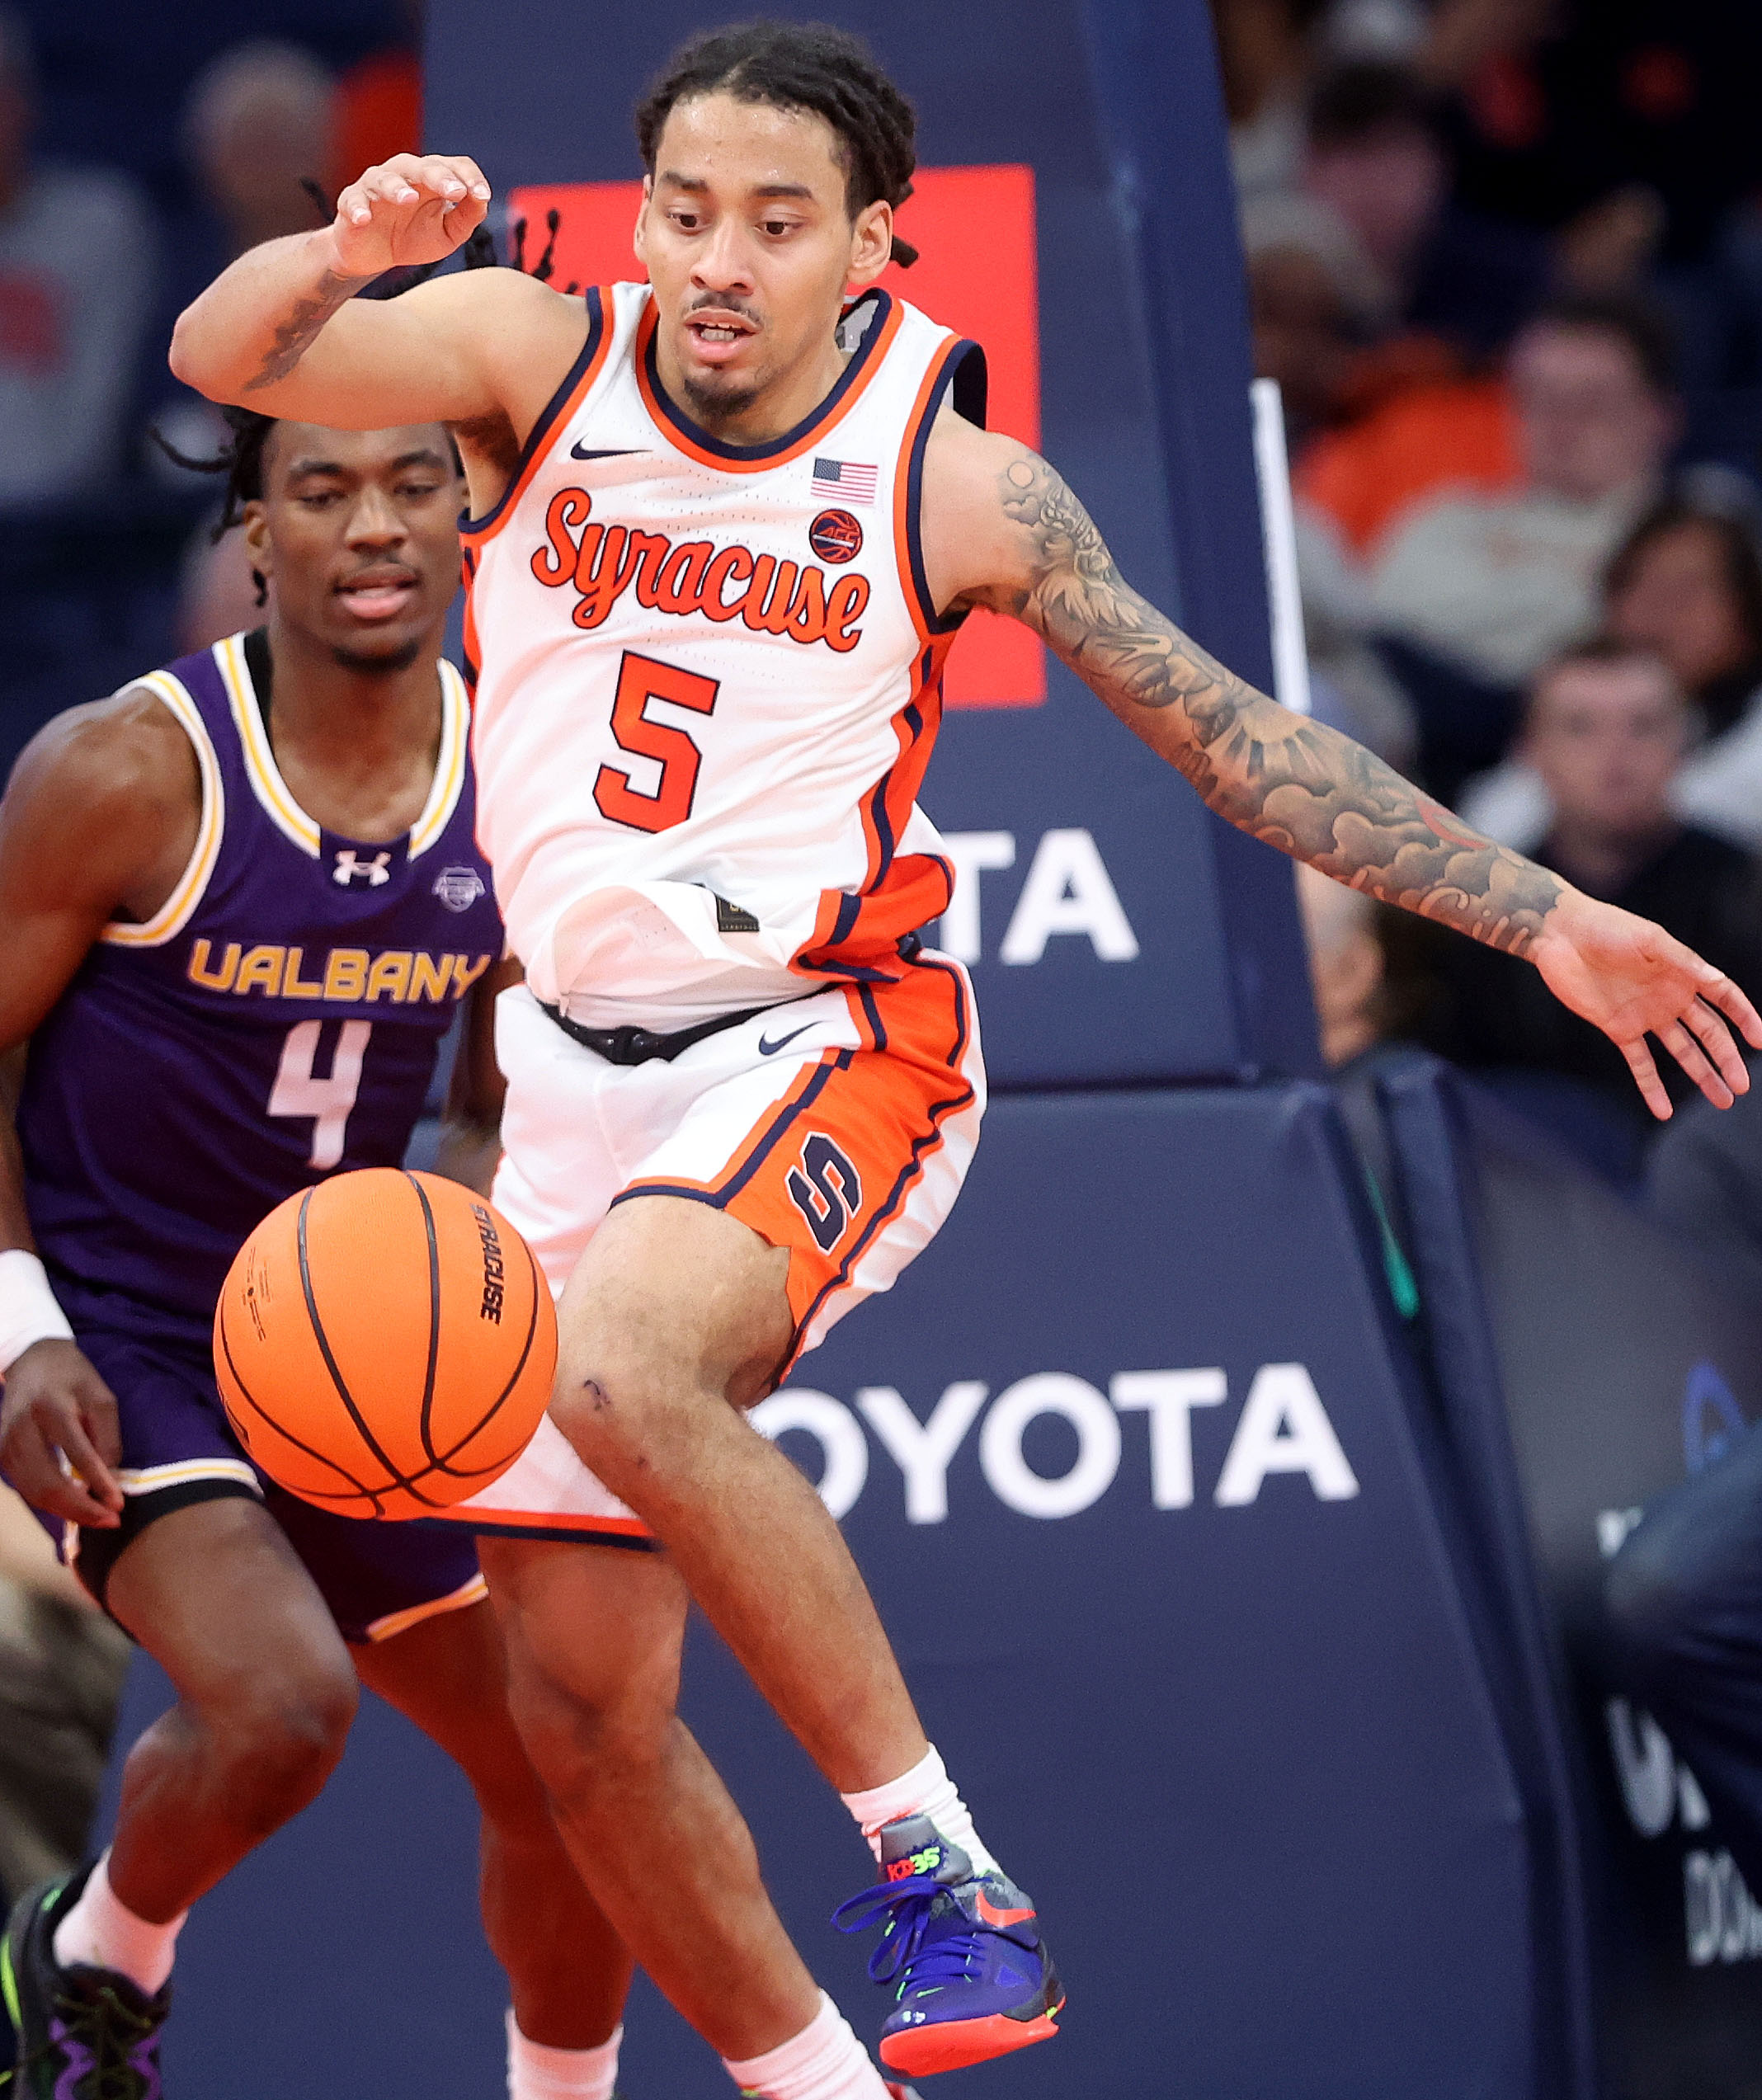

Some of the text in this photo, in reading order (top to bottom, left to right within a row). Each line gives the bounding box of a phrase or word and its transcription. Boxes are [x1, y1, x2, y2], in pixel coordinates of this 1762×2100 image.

[530, 487, 870, 653] Syracuse
[592, 649, 721, 834] 5
[187, 938, 492, 1004] UALBANY
[267, 1019, 373, 1171] 4
[747, 1362, 1361, 1525] OYOTA
